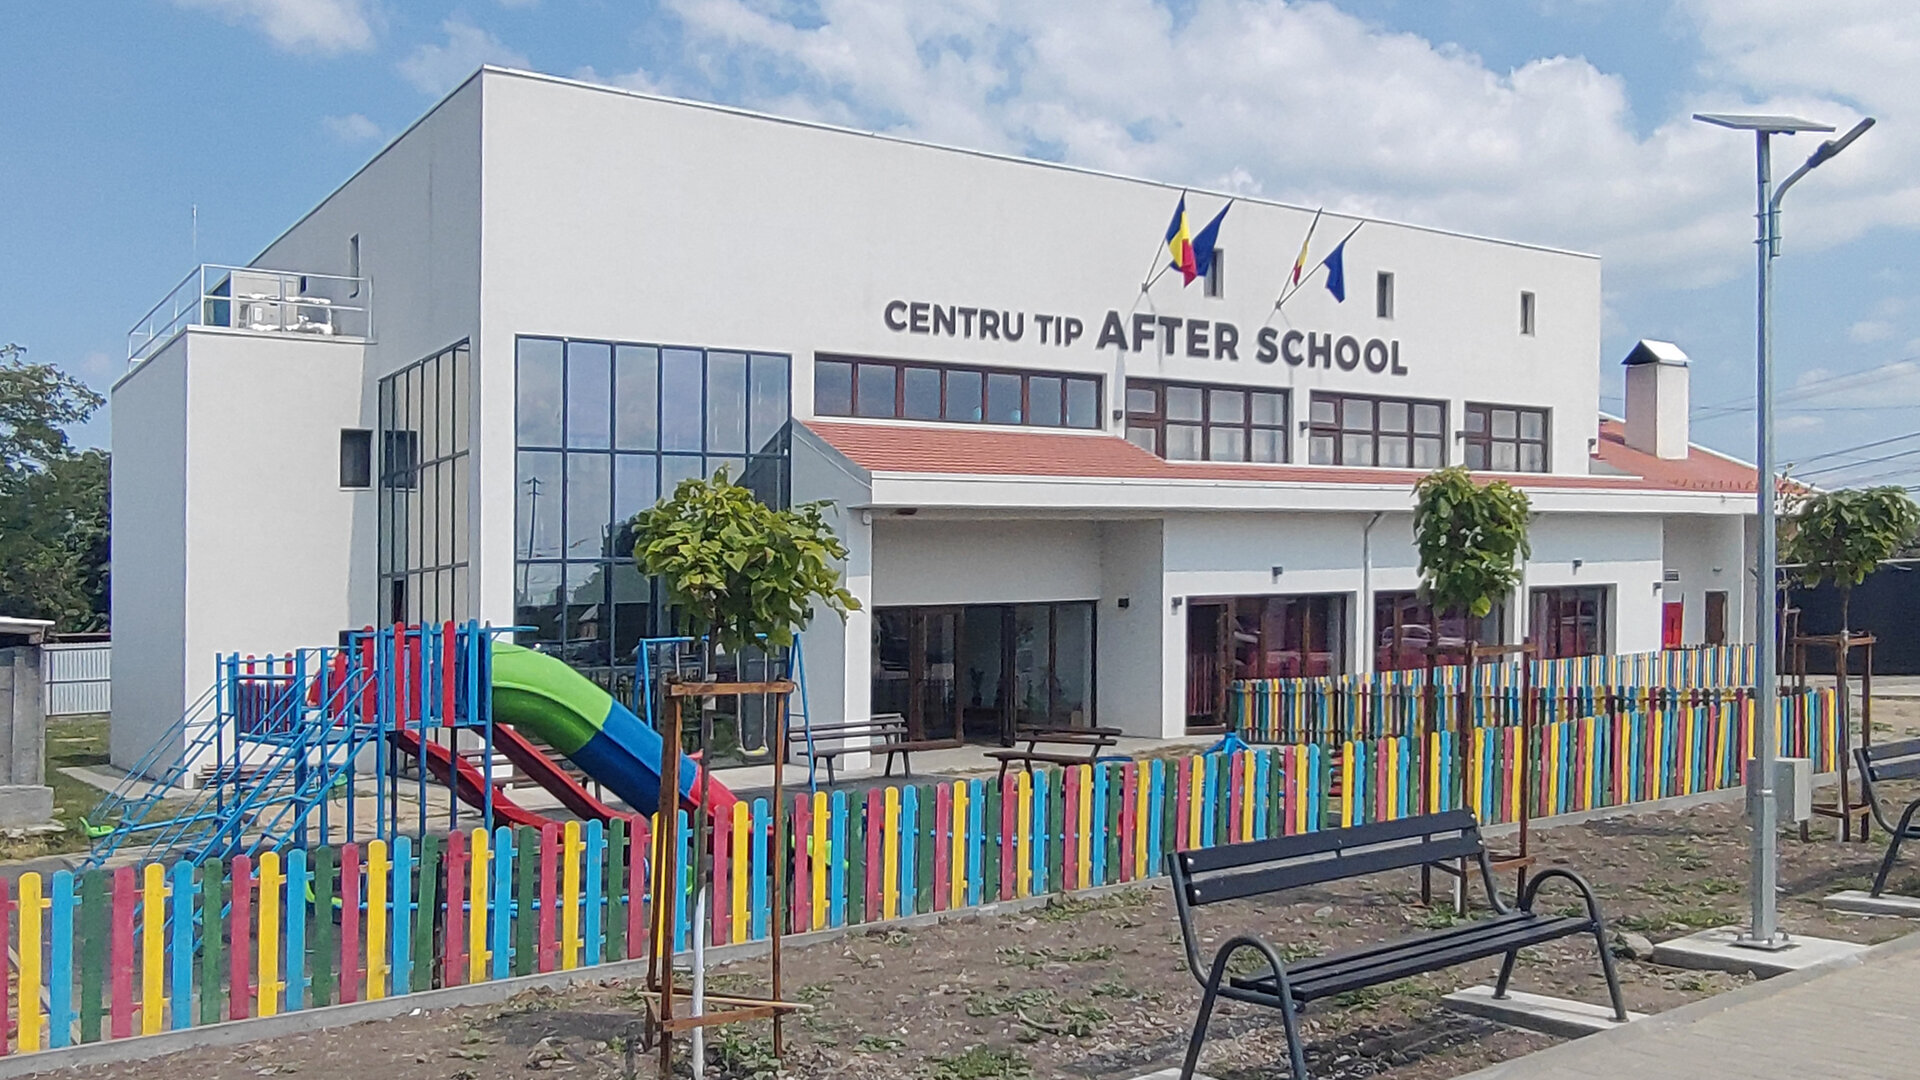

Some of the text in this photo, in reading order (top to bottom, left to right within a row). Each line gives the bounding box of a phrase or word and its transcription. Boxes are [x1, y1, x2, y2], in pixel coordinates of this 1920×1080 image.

[885, 300, 1408, 376] CENTRU TIP AFTER SCHOOL
